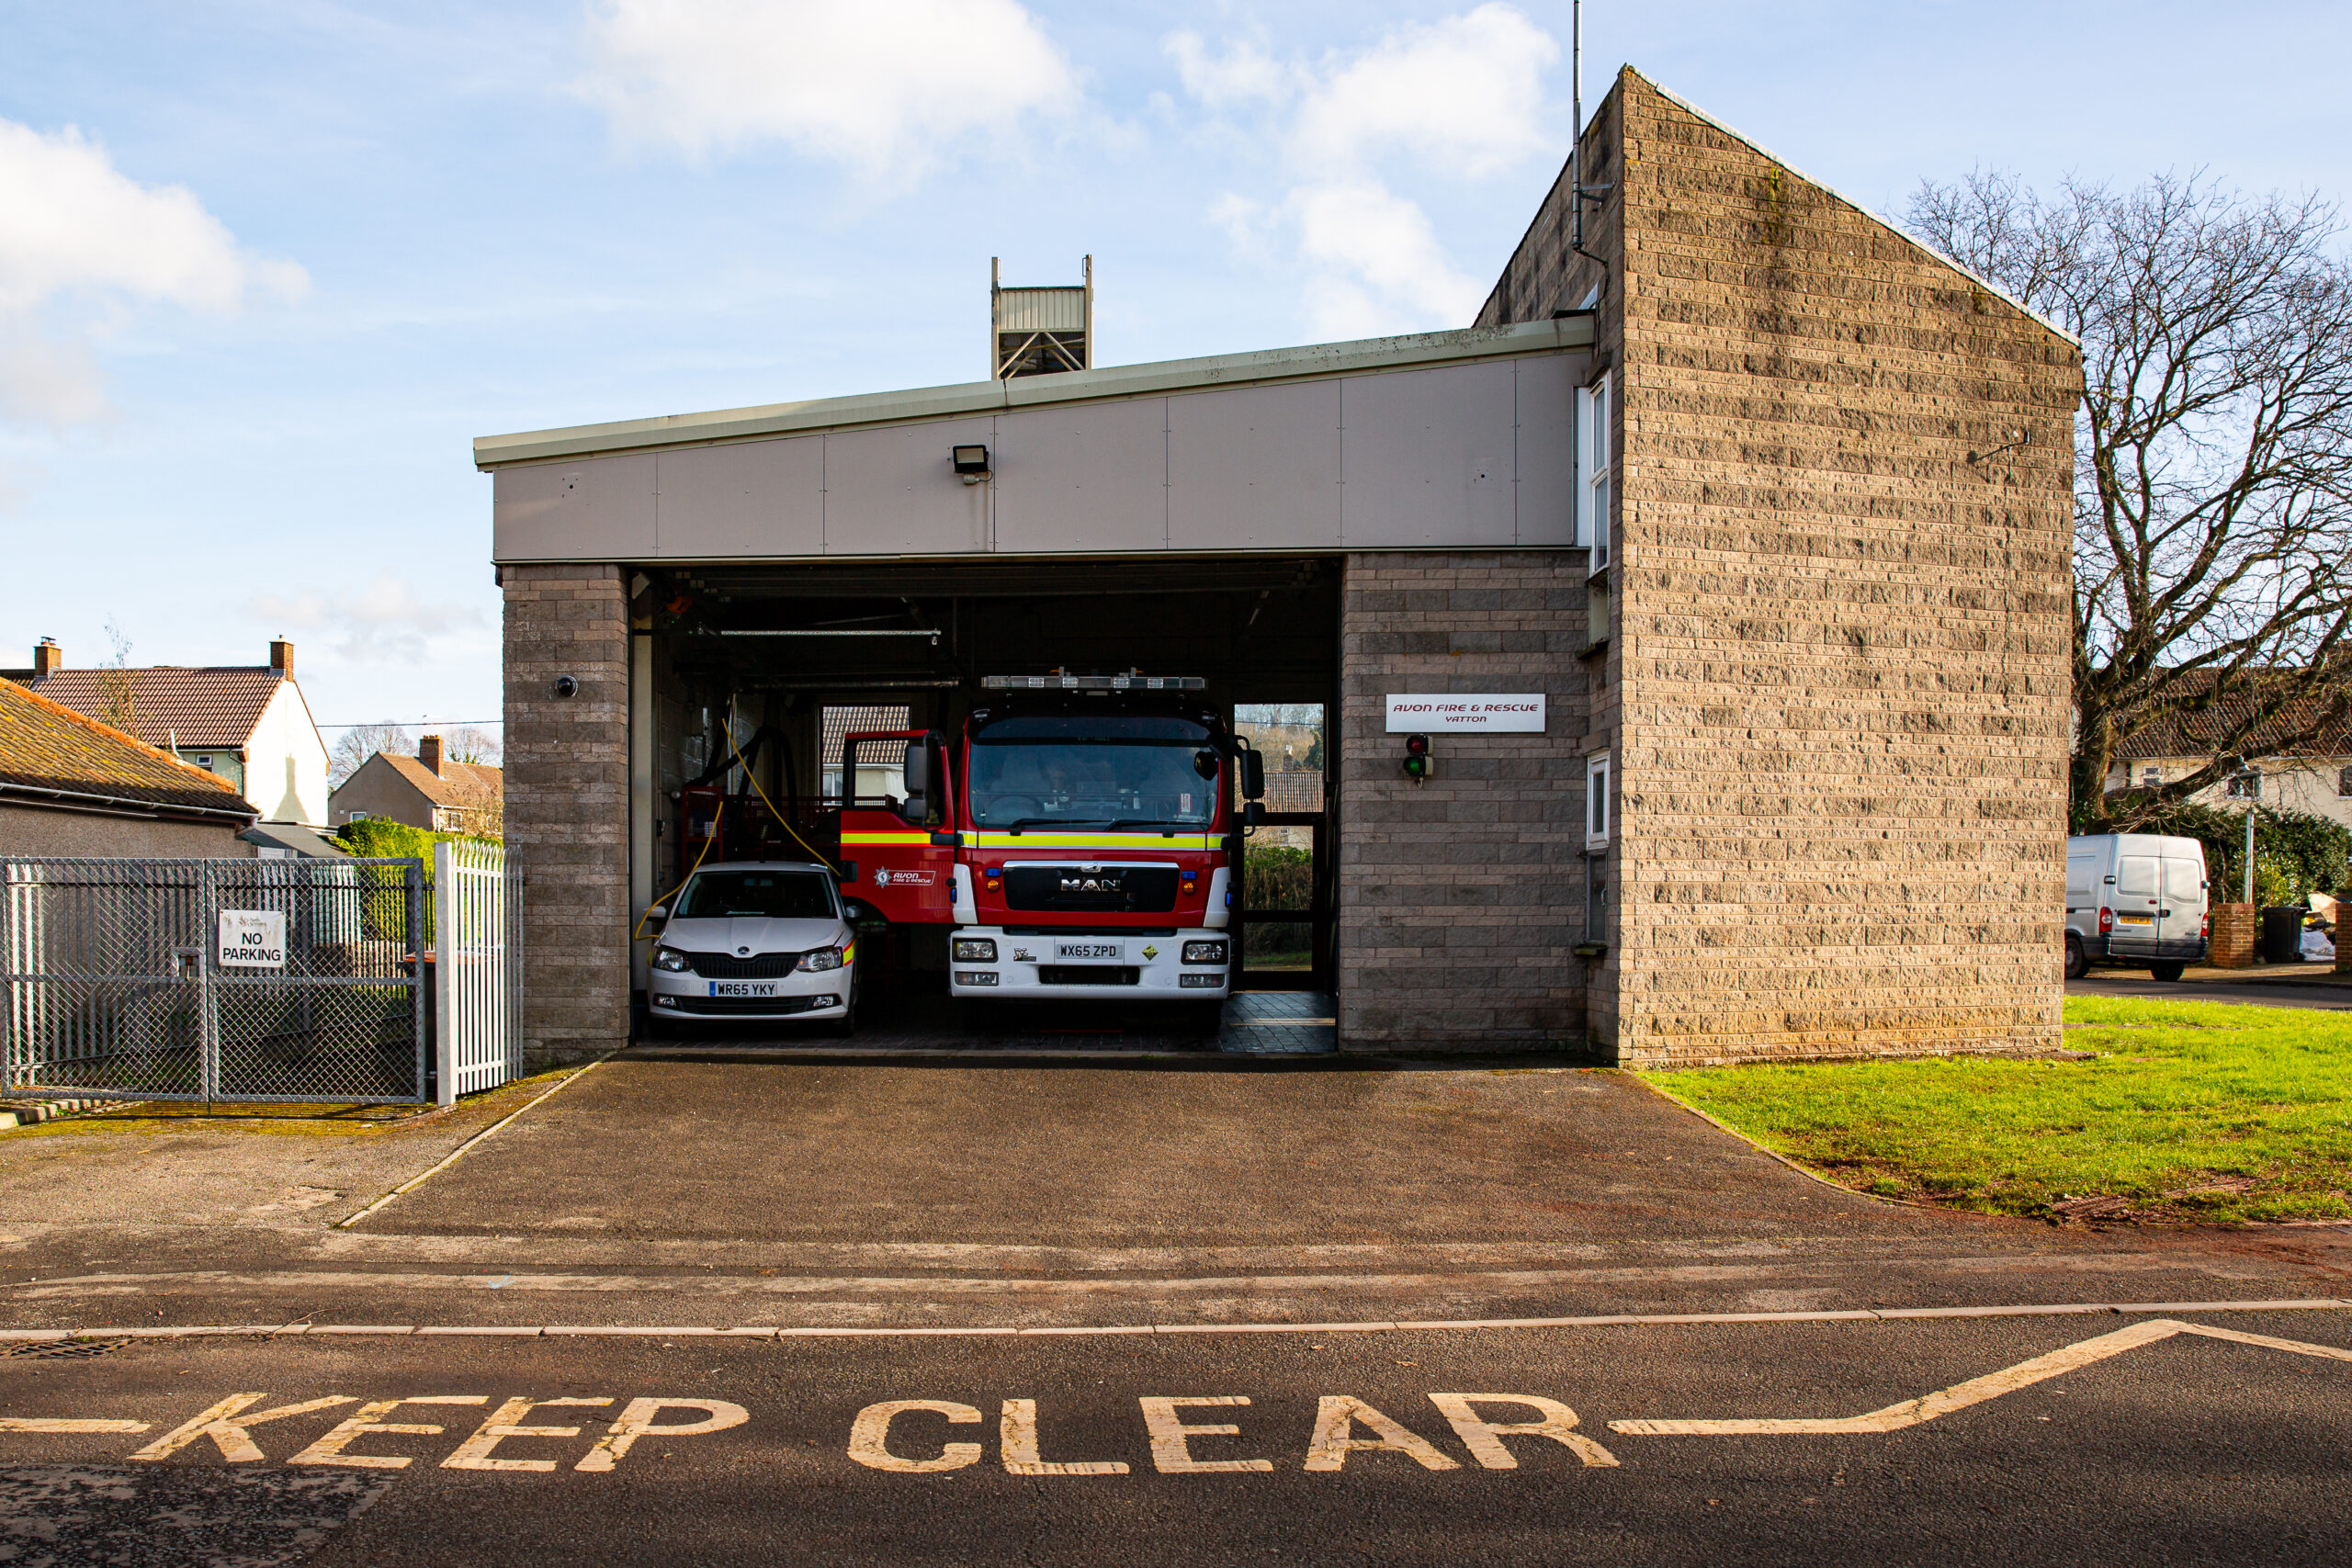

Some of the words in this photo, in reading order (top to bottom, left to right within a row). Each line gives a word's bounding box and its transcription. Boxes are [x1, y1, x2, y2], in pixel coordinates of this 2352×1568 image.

[1393, 704, 1432, 712] AVON
[1436, 704, 1467, 712] FIRE
[1470, 704, 1481, 712] &
[1484, 704, 1539, 712] RESCUE
[1060, 878, 1121, 892] MAN
[242, 932, 263, 945] NO
[222, 947, 281, 961] PARKING
[1060, 944, 1091, 957] WX65
[1092, 945, 1116, 957] ZPD
[718, 983, 749, 996] WR65
[752, 983, 775, 996] YKY
[127, 1391, 750, 1472] KEEP
[846, 1392, 1621, 1475] CLEAR
